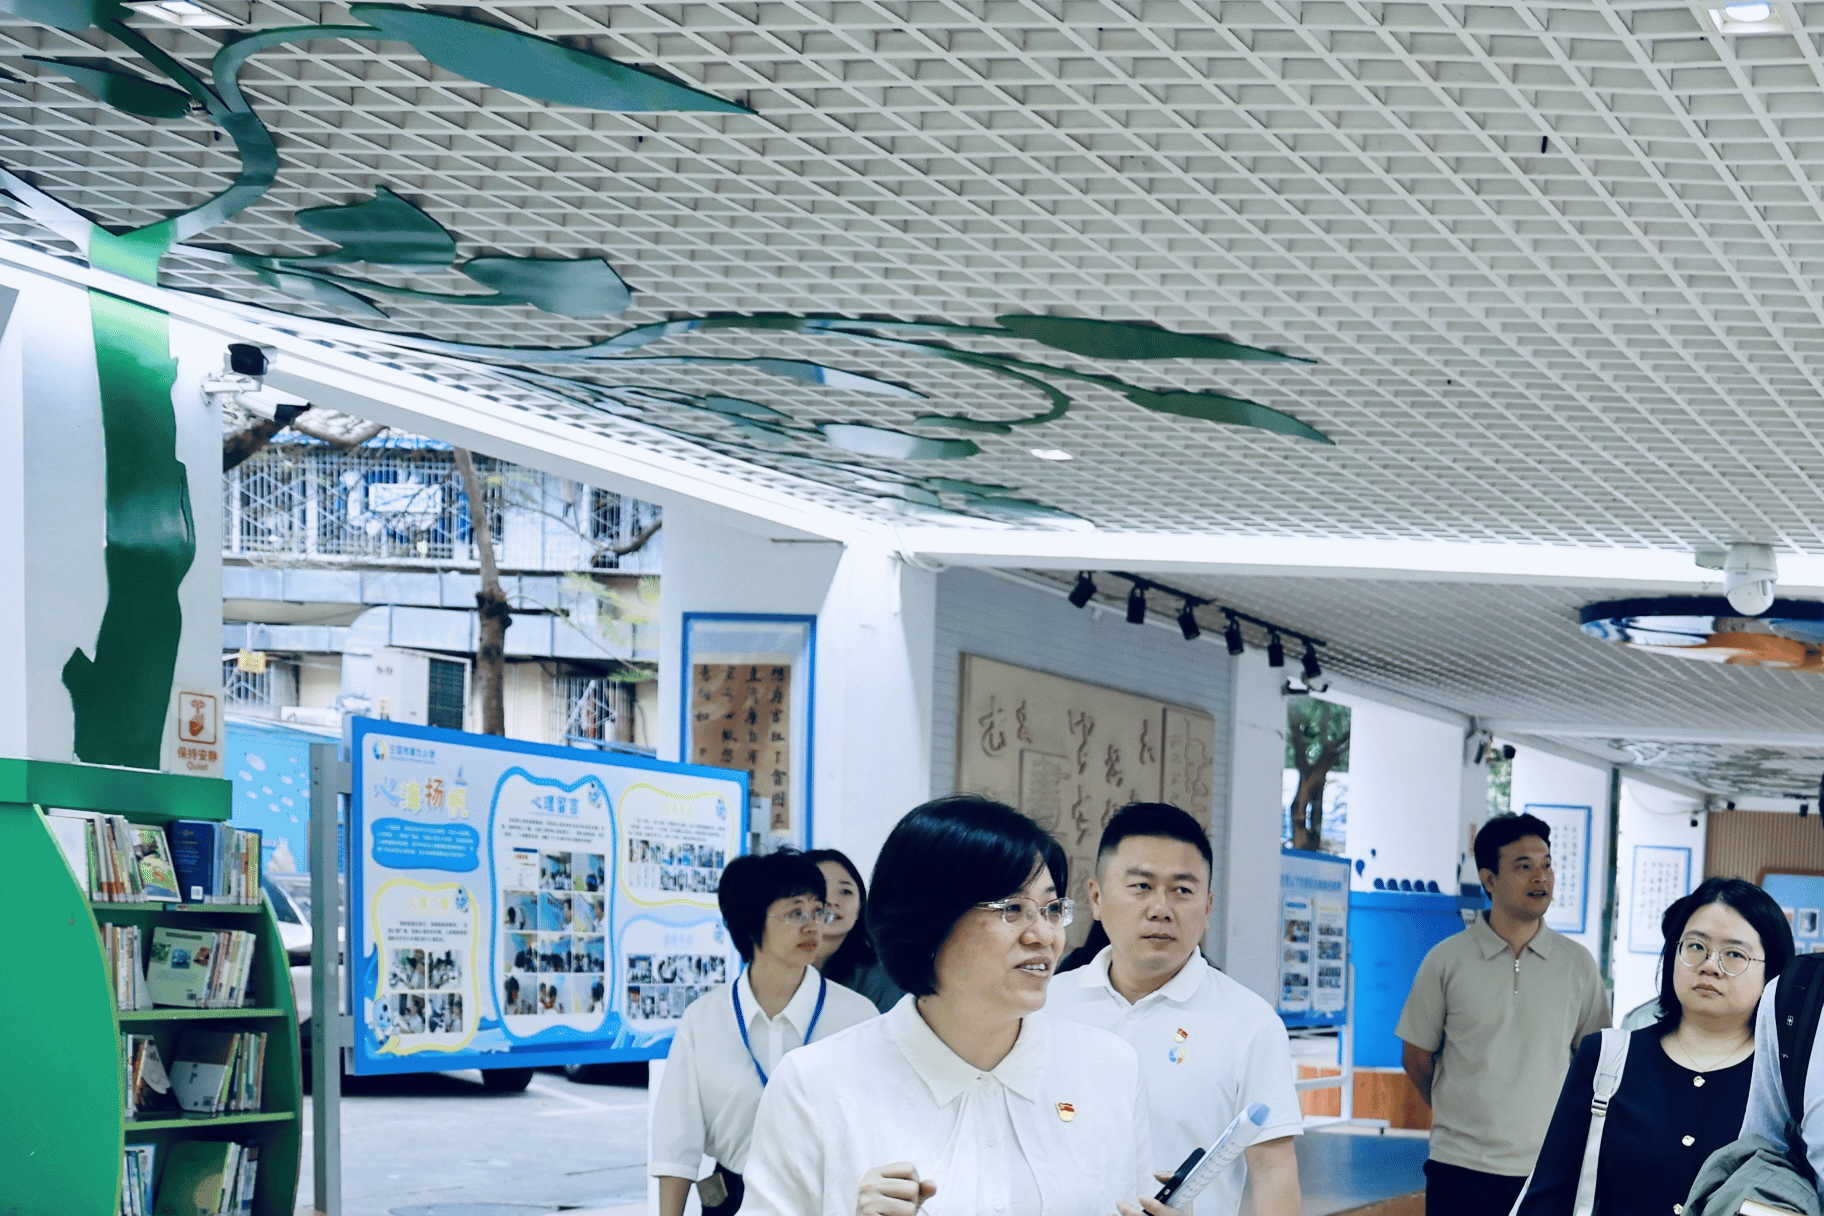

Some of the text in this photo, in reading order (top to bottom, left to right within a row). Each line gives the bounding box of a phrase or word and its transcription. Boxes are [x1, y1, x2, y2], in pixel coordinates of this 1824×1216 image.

[177, 746, 218, 762] 保持安静
[373, 775, 470, 820] 心海扬帆
